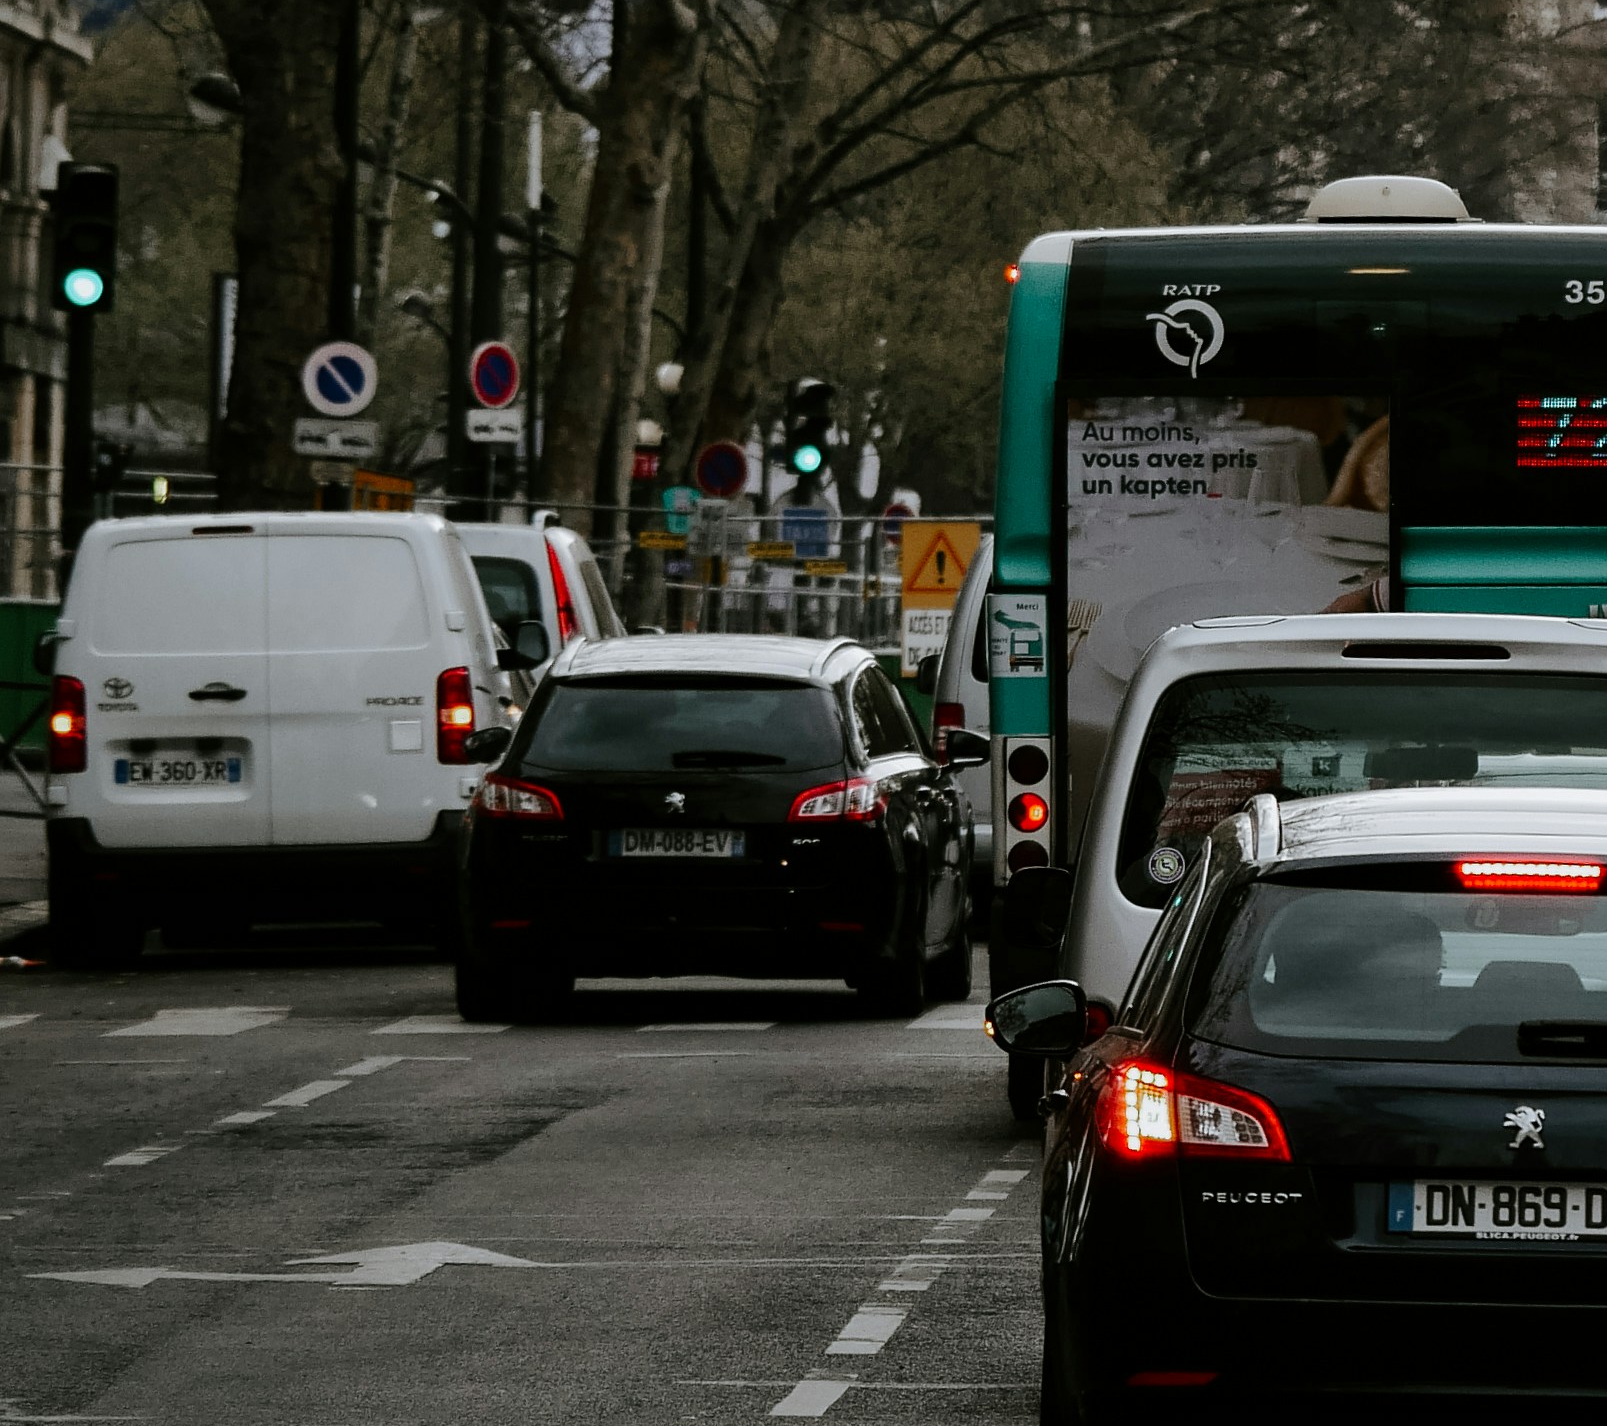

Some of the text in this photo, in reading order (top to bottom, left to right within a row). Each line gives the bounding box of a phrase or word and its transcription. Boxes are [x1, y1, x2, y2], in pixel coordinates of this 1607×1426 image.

[1163, 284, 1221, 296] RATP
[1082, 423, 1200, 445] Au moins,
[1082, 449, 1258, 474] vous avez pris
[1082, 479, 1112, 494] un
[1016, 603, 1039, 611] Merci
[366, 696, 424, 706] PROACE
[130, 761, 227, 781] EW-360-XR
[623, 832, 729, 853] DM-088-EV
[1202, 1191, 1303, 1205] PEUGEOT
[1396, 1210, 1405, 1223] F
